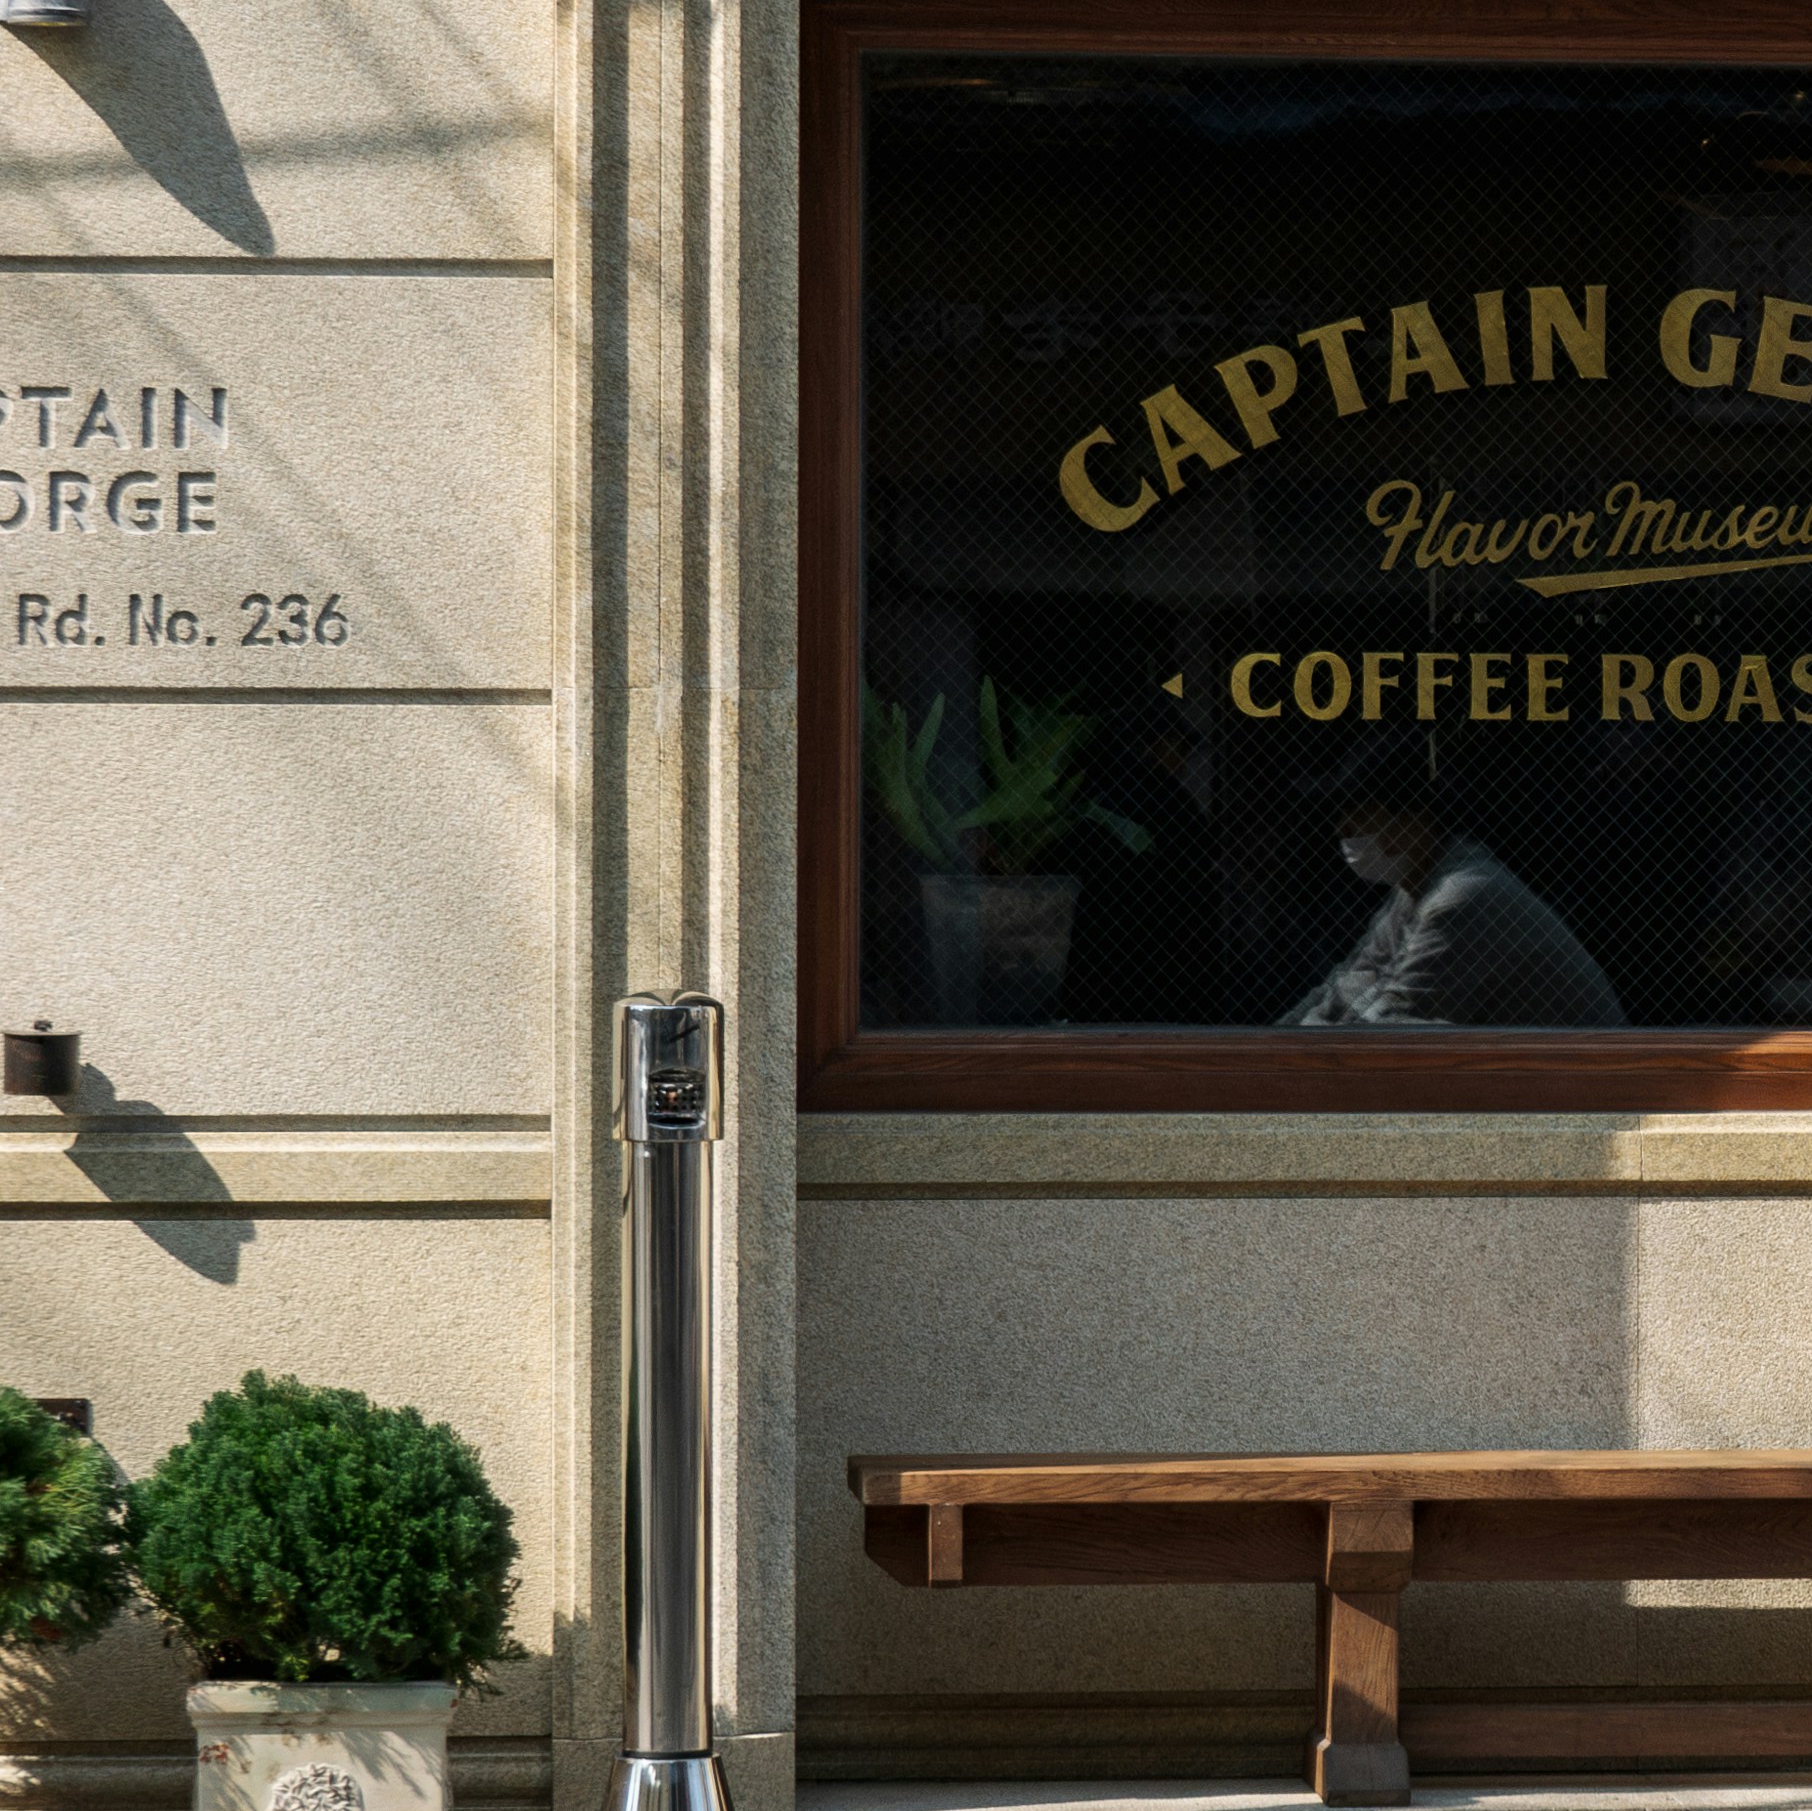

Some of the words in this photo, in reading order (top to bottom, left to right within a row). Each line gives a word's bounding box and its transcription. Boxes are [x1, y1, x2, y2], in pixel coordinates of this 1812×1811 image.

[1059, 285, 1608, 532] CAPTAIN
[1366, 479, 1598, 570] Flavor
[18, 593, 106, 648] Rd.
[129, 593, 217, 647] No.
[240, 593, 350, 647] 236
[1231, 651, 1570, 722] COFFEE
